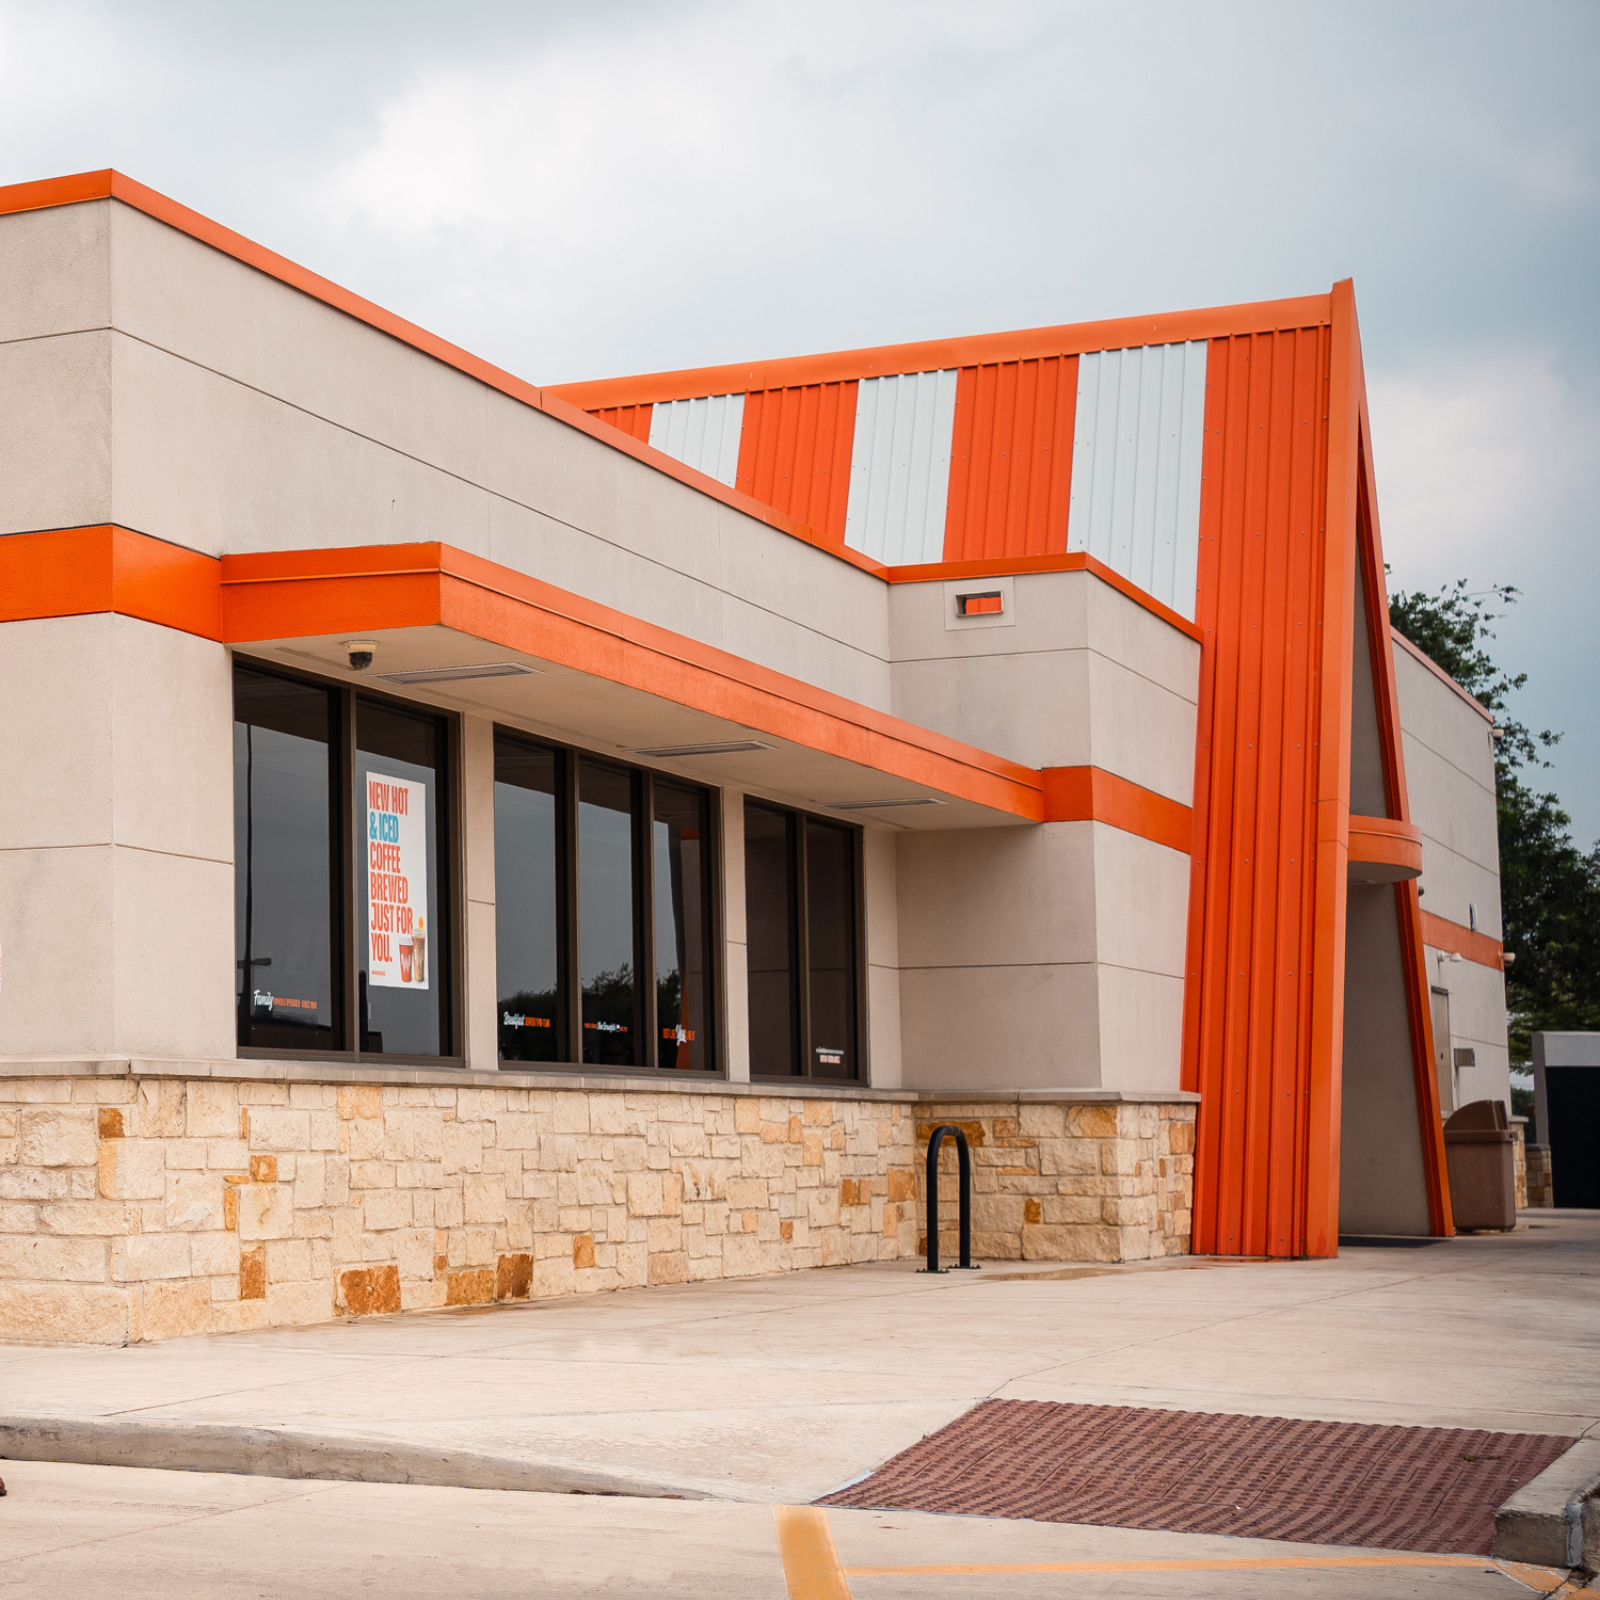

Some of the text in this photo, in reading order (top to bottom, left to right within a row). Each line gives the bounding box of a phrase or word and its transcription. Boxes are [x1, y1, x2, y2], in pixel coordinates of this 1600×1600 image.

[369, 781, 409, 816] NEW HOT
[370, 811, 399, 843] & ICED
[370, 841, 401, 873] COFFEE
[371, 872, 409, 904] BREWED
[371, 902, 413, 934] JUST FOR
[371, 933, 393, 963] YOU.
[254, 989, 274, 1011] Family
